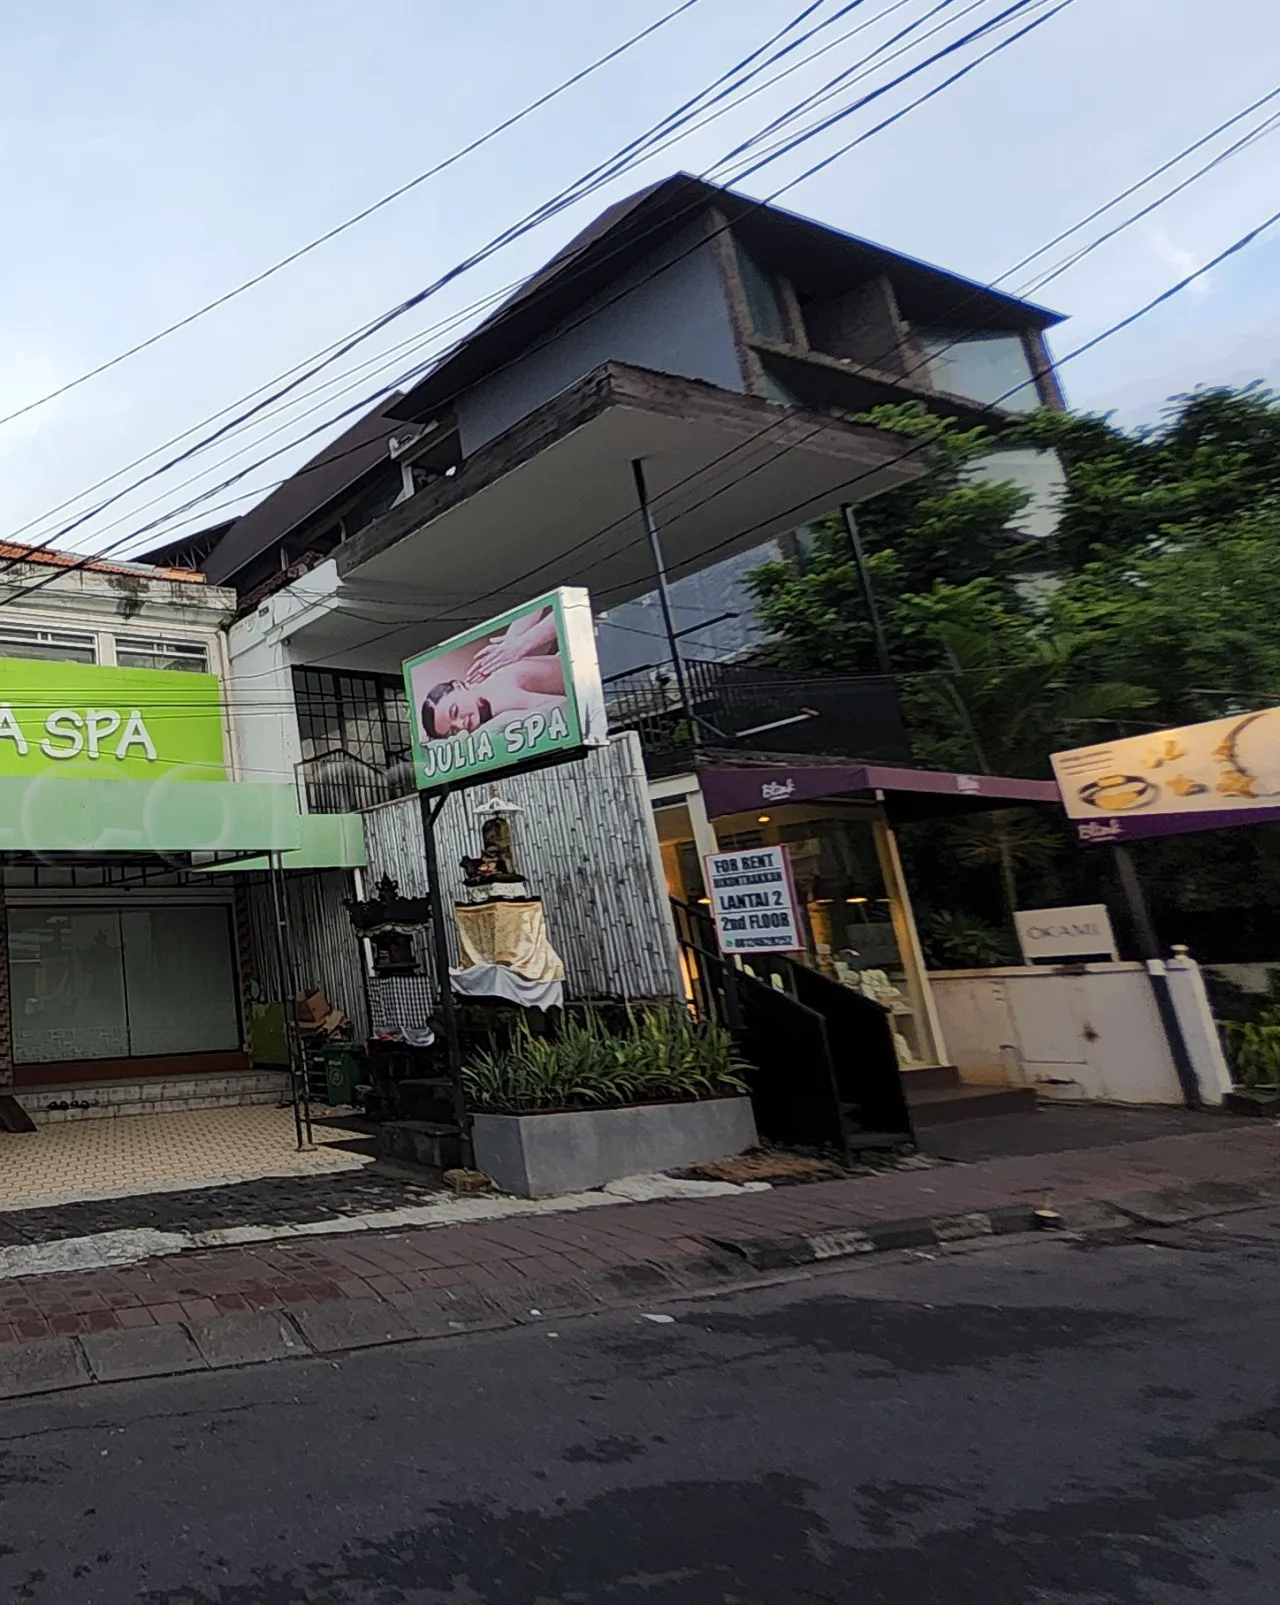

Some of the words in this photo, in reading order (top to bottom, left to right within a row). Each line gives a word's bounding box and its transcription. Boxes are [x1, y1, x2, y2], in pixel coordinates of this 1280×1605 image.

[39, 709, 158, 762] SPA
[424, 731, 495, 777] JULIA
[504, 706, 569, 755] SPA
[714, 859, 738, 873] FOR
[741, 853, 773, 870] RENT
[720, 892, 769, 910] LANTAI
[772, 890, 783, 906] 2
[722, 916, 747, 931] 2nd
[748, 913, 790, 929] FLOOR
